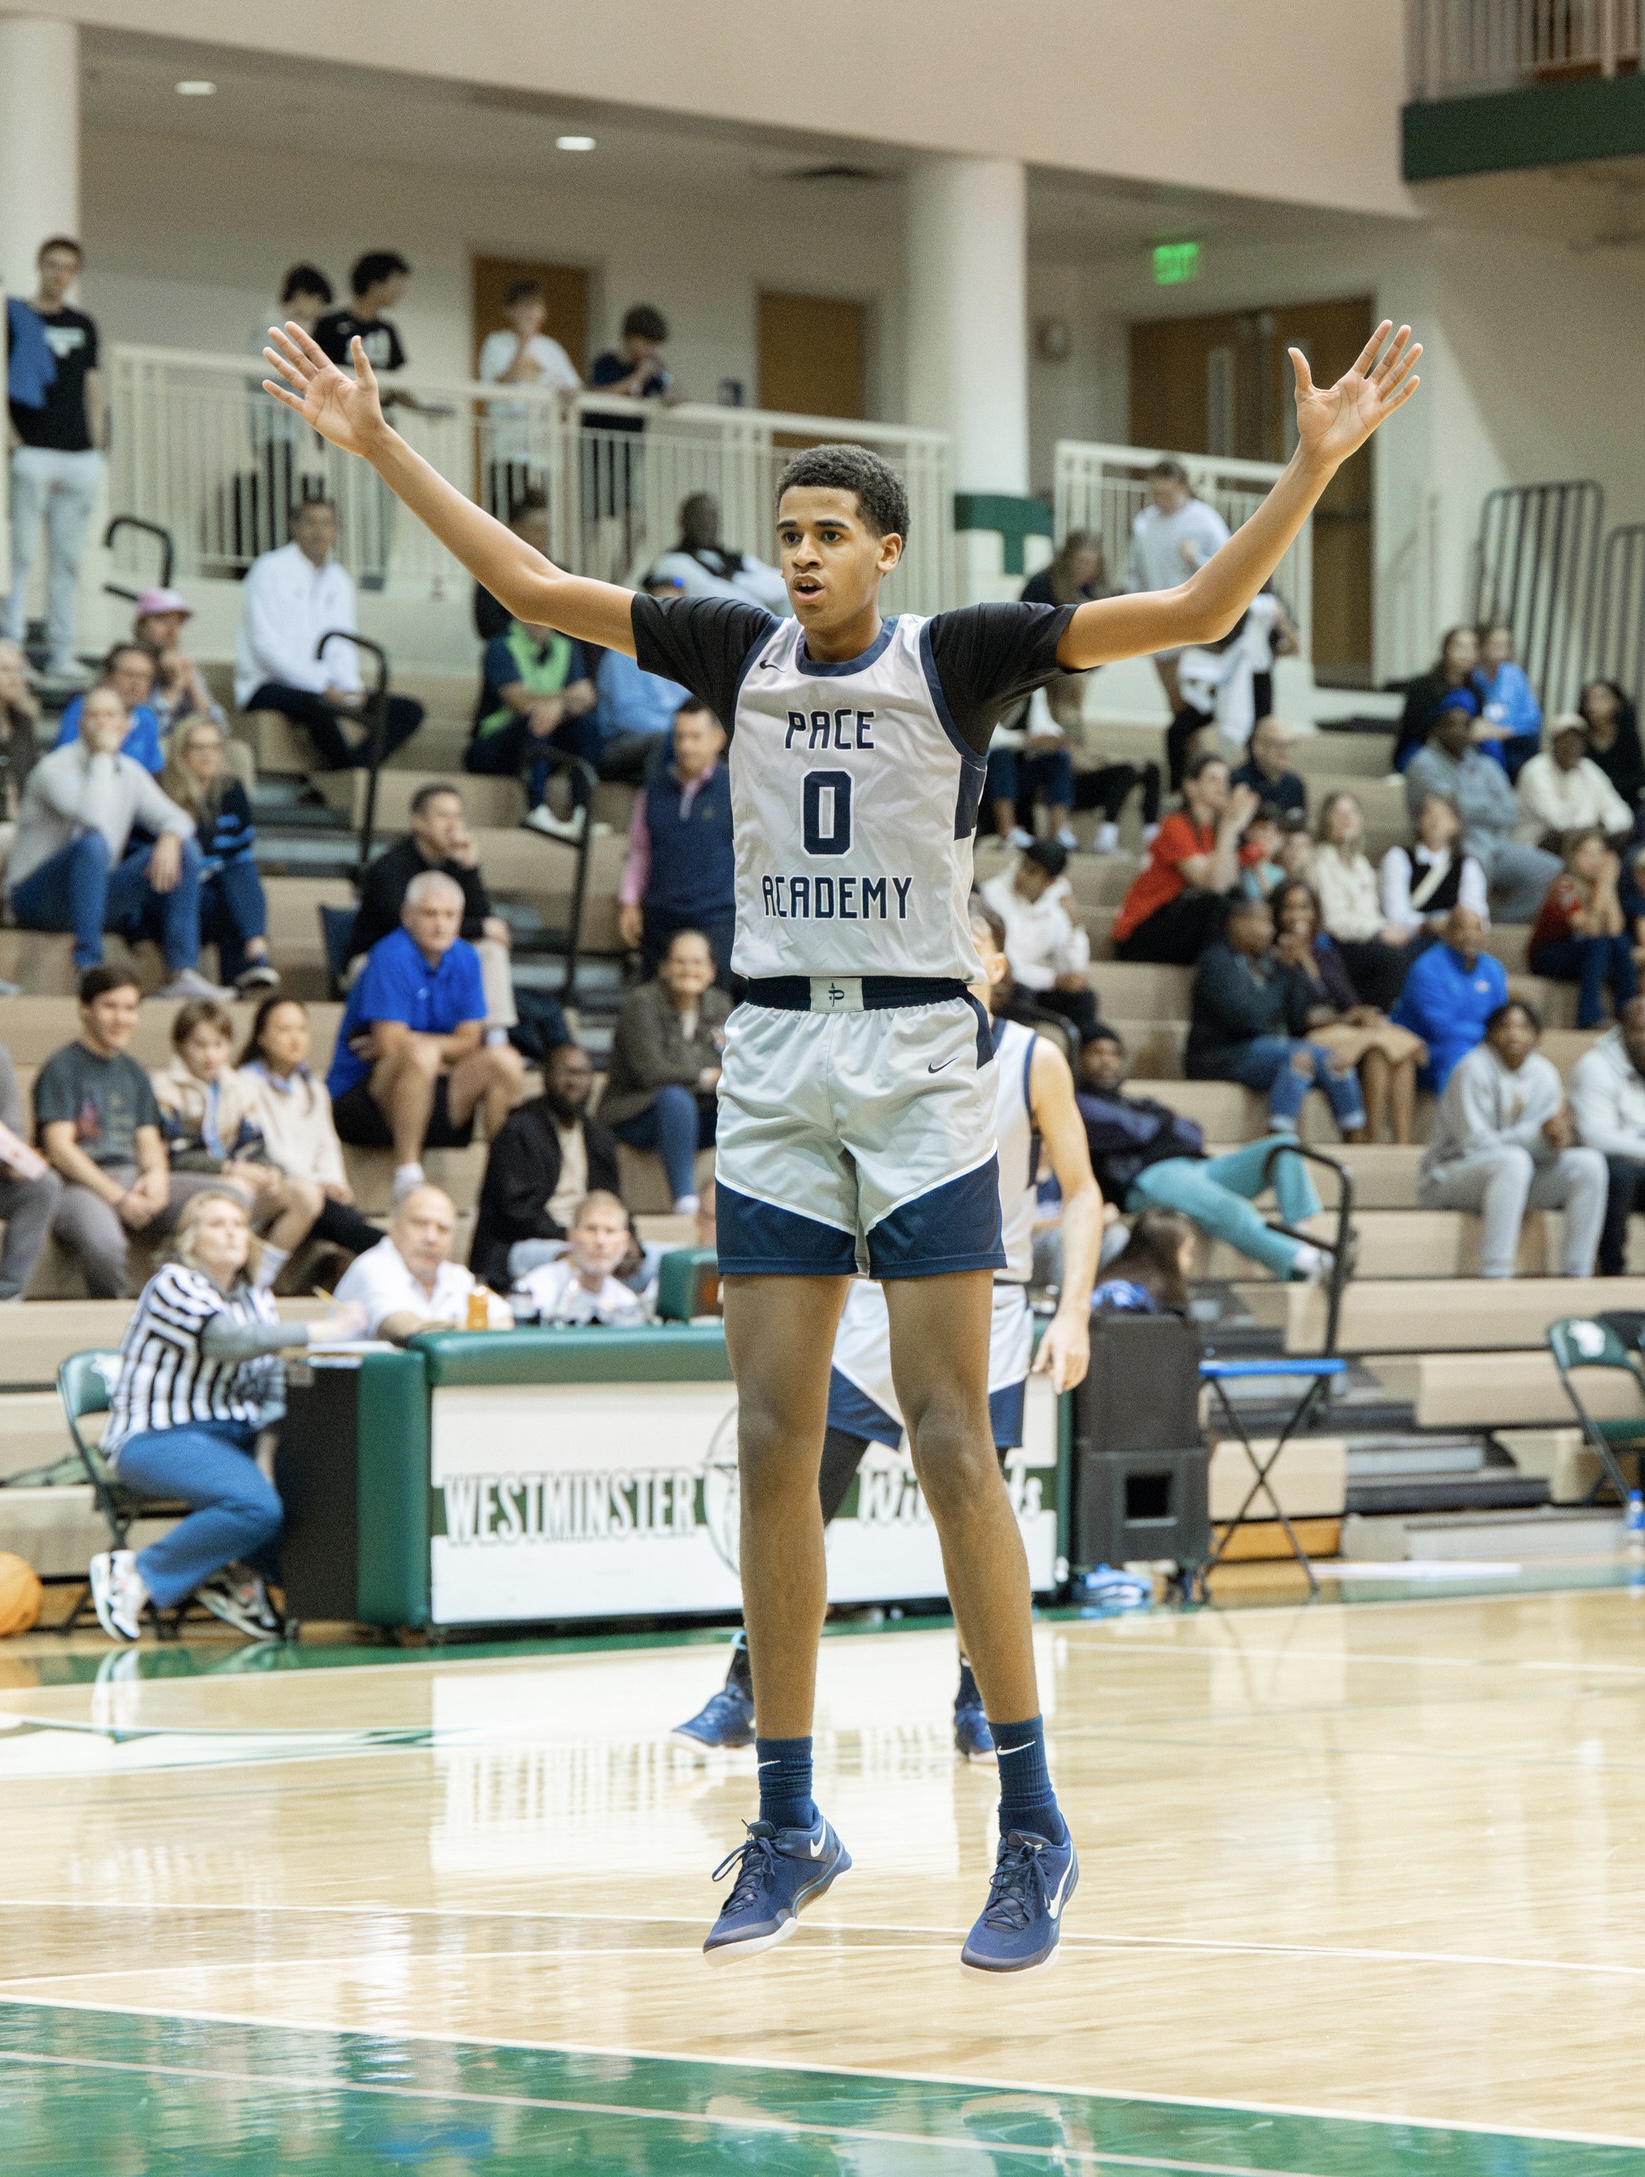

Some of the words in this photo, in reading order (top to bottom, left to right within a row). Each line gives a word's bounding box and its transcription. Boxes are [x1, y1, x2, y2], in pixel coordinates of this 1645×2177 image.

[785, 708, 876, 751] PACE
[801, 767, 854, 858] 0
[761, 874, 914, 920] ACADEMY
[443, 1468, 698, 1546] WESTMINSTER
